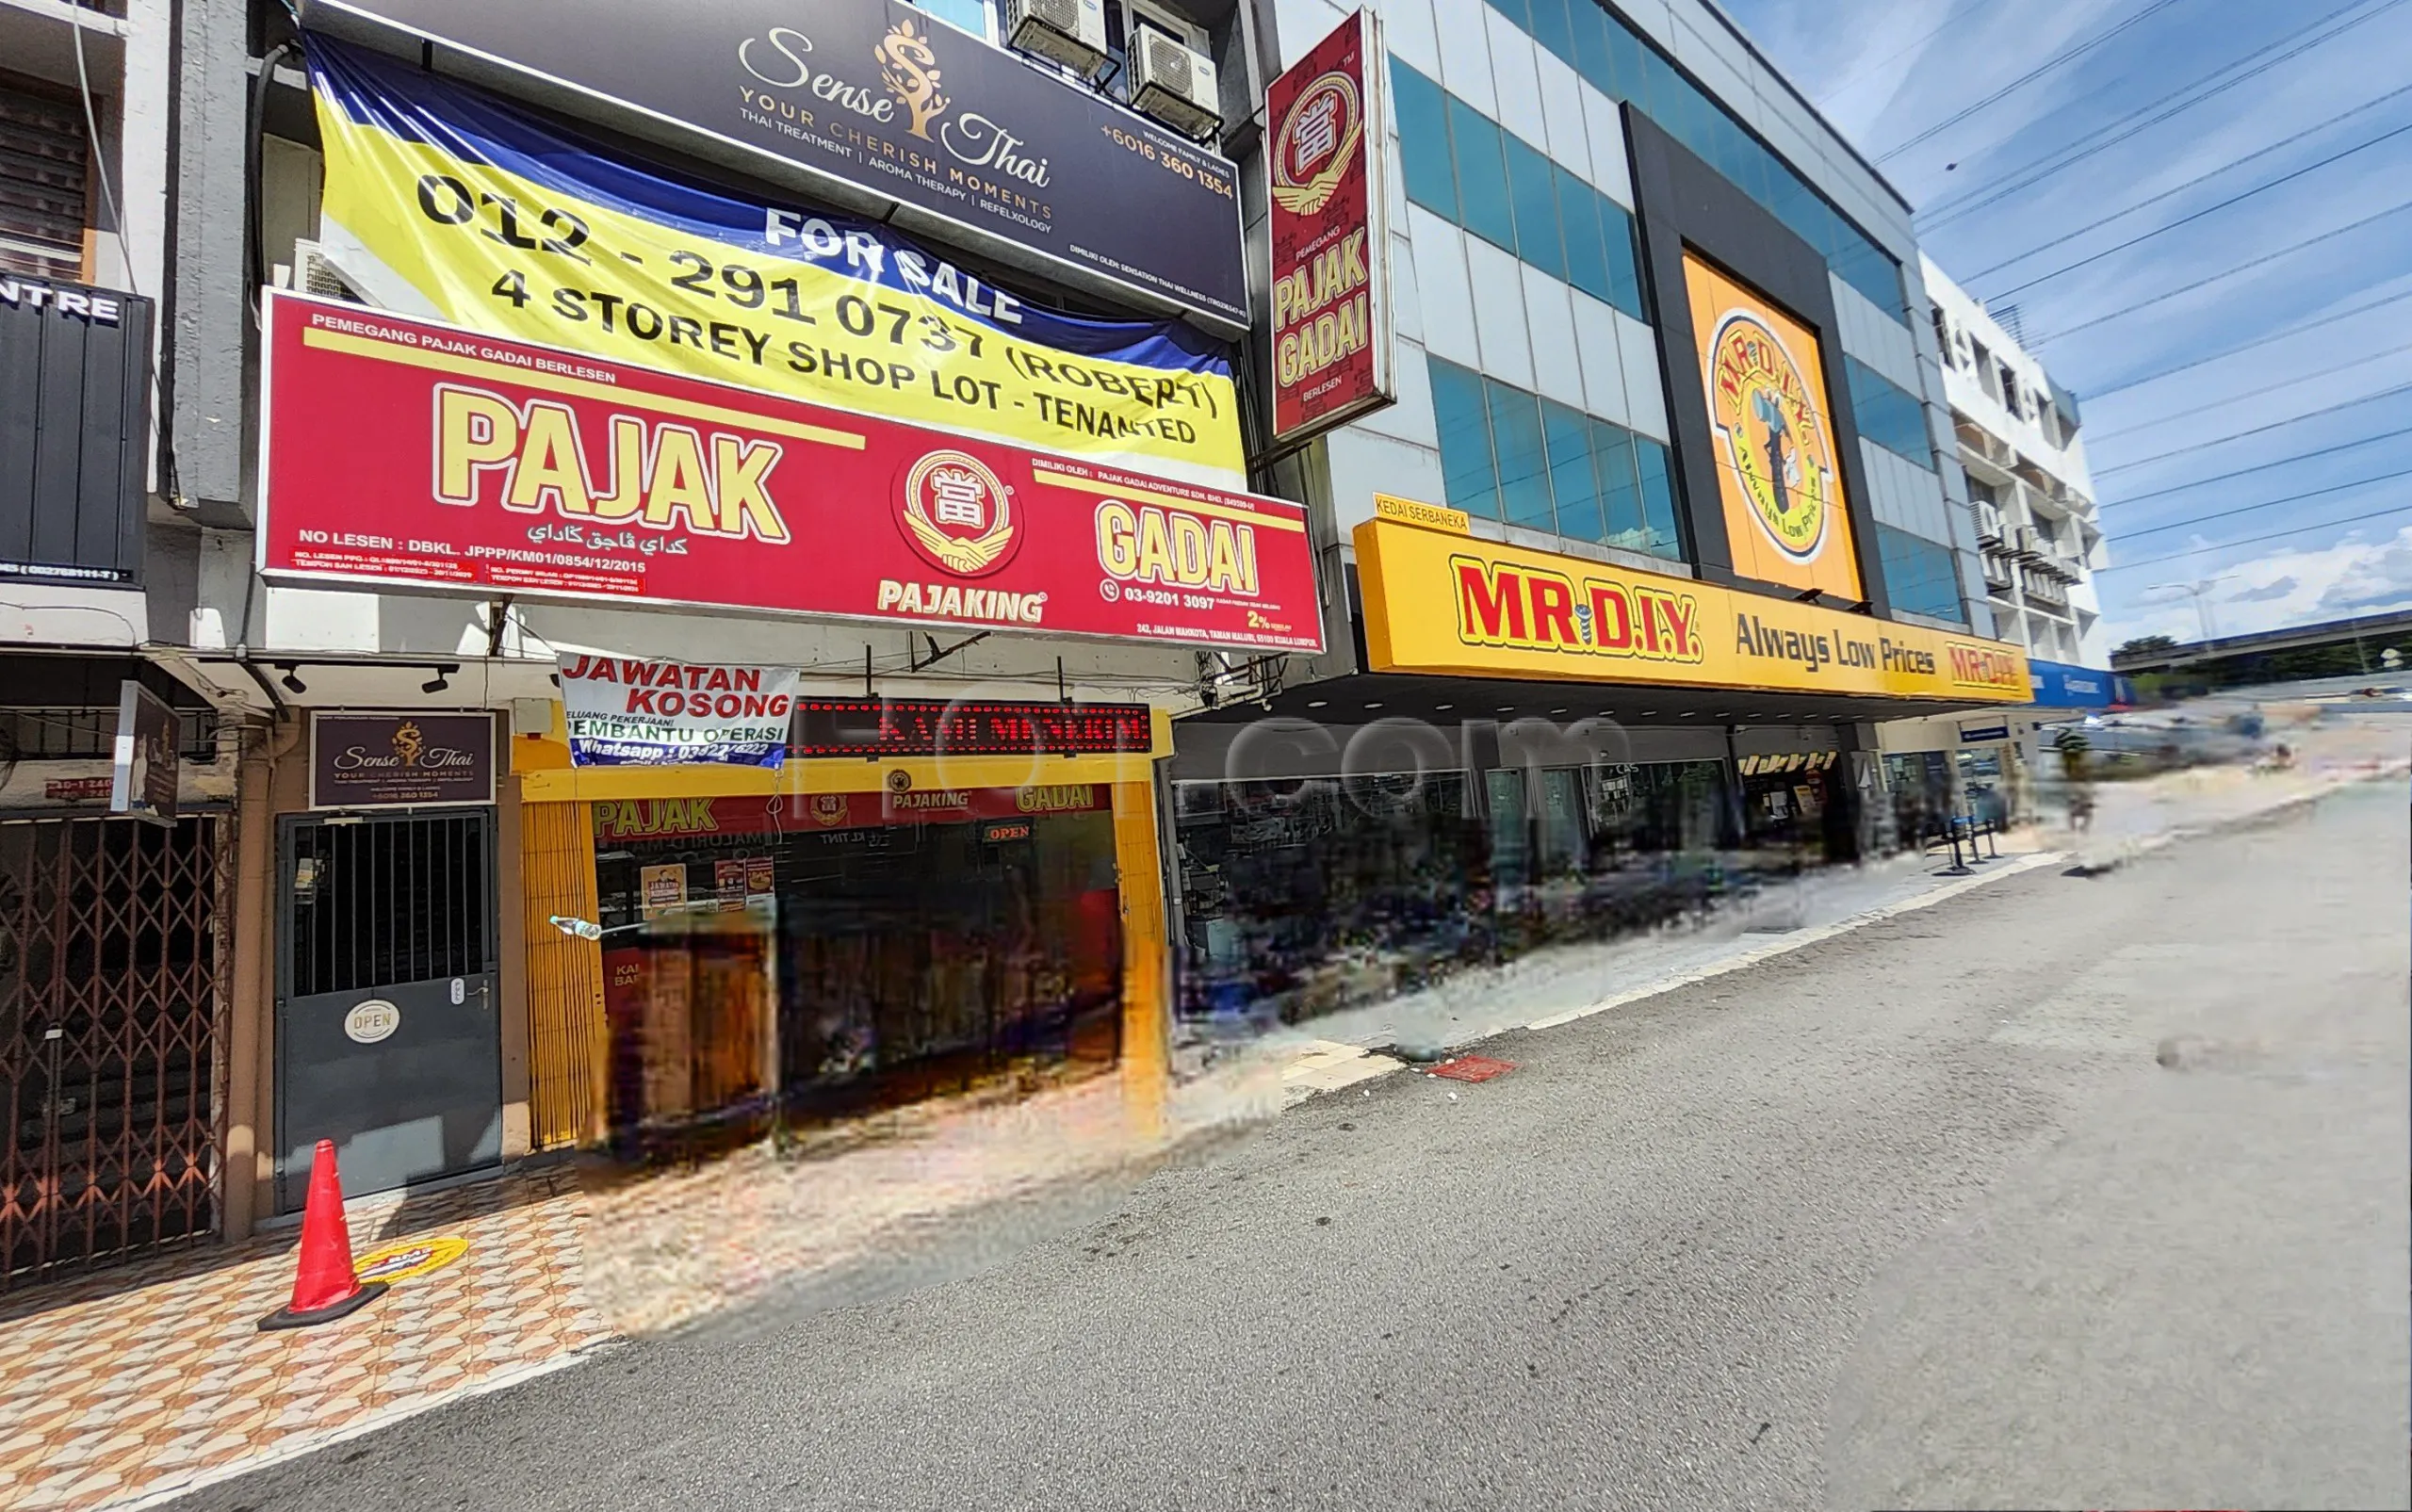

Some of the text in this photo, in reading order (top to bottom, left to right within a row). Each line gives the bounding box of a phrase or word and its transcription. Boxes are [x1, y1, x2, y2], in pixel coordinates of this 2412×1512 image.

[739, 27, 1051, 188] Sense Thai
[740, 86, 1052, 219] YOUR CHERISH MOMENTS
[1100, 124, 1233, 200] +6016 360 1354
[1143, 130, 1178, 153] WELCOME
[1178, 148, 1201, 163] FAMILY
[740, 107, 1052, 235] THAI TREATMENT AROMA THERAPY REFELXOLOGY
[1295, 225, 1341, 262] PEMEGANG
[765, 207, 1023, 324] FOR SALE
[1274, 226, 1368, 333] PAJAK
[0, 280, 120, 320] NTRE
[416, 174, 592, 267] 012
[667, 250, 817, 326] 291
[835, 294, 985, 359] 0737
[1004, 346, 1217, 420] (ROBERT)
[1174, 284, 1207, 302] WELLNESS
[312, 313, 616, 384] PEMEGANG PAJAK GADAI BERLESEN
[491, 268, 531, 309] 4
[551, 287, 772, 366] STOREY
[787, 340, 915, 391] SHOP
[929, 369, 1002, 410] LOT
[1033, 391, 1197, 445] TENANTED
[1278, 291, 1369, 389] GADAI
[1303, 376, 1343, 402] BERLESEN
[432, 382, 791, 545] PAJAK
[1032, 458, 1066, 471] DIMILIKI
[1067, 464, 1088, 476] OLEH
[1098, 471, 1123, 485] PAJAK
[1124, 476, 1149, 489] GADAI
[1148, 480, 1190, 497] ADVENTURE
[930, 468, 986, 529] 當
[1376, 497, 1468, 530] KEDAI SERBANEKA
[299, 528, 329, 544] NO
[333, 532, 393, 549] LESEN
[408, 540, 461, 556] DBKL.
[464, 545, 646, 573] JPPP/KM01/0854/12/2015
[1094, 498, 1261, 597] GADAI
[877, 579, 1043, 623] PAJAKING
[1124, 587, 1180, 607] 03-9201
[1183, 594, 1214, 610] 3097
[1136, 623, 1152, 634] 242,
[1152, 625, 1174, 636] JALAN
[1209, 629, 1230, 640] TAMAN
[1274, 635, 1294, 645] KUALA
[1247, 610, 1270, 629] 2%
[1736, 613, 1936, 675] Always Low Prices
[562, 655, 761, 692] JAWATAN
[609, 714, 675, 727] PEKERJAAN!
[626, 688, 789, 719] KOSONG
[579, 739, 663, 760] Whatsapp
[703, 726, 784, 742] OPERASI
[334, 746, 474, 770] Sense Thai
[592, 798, 720, 837] PAJAK
[893, 792, 969, 809] PAJAKING
[1016, 785, 1095, 813] GADAI
[989, 825, 1030, 840] OPEN
[354, 1013, 392, 1030] OPEN
